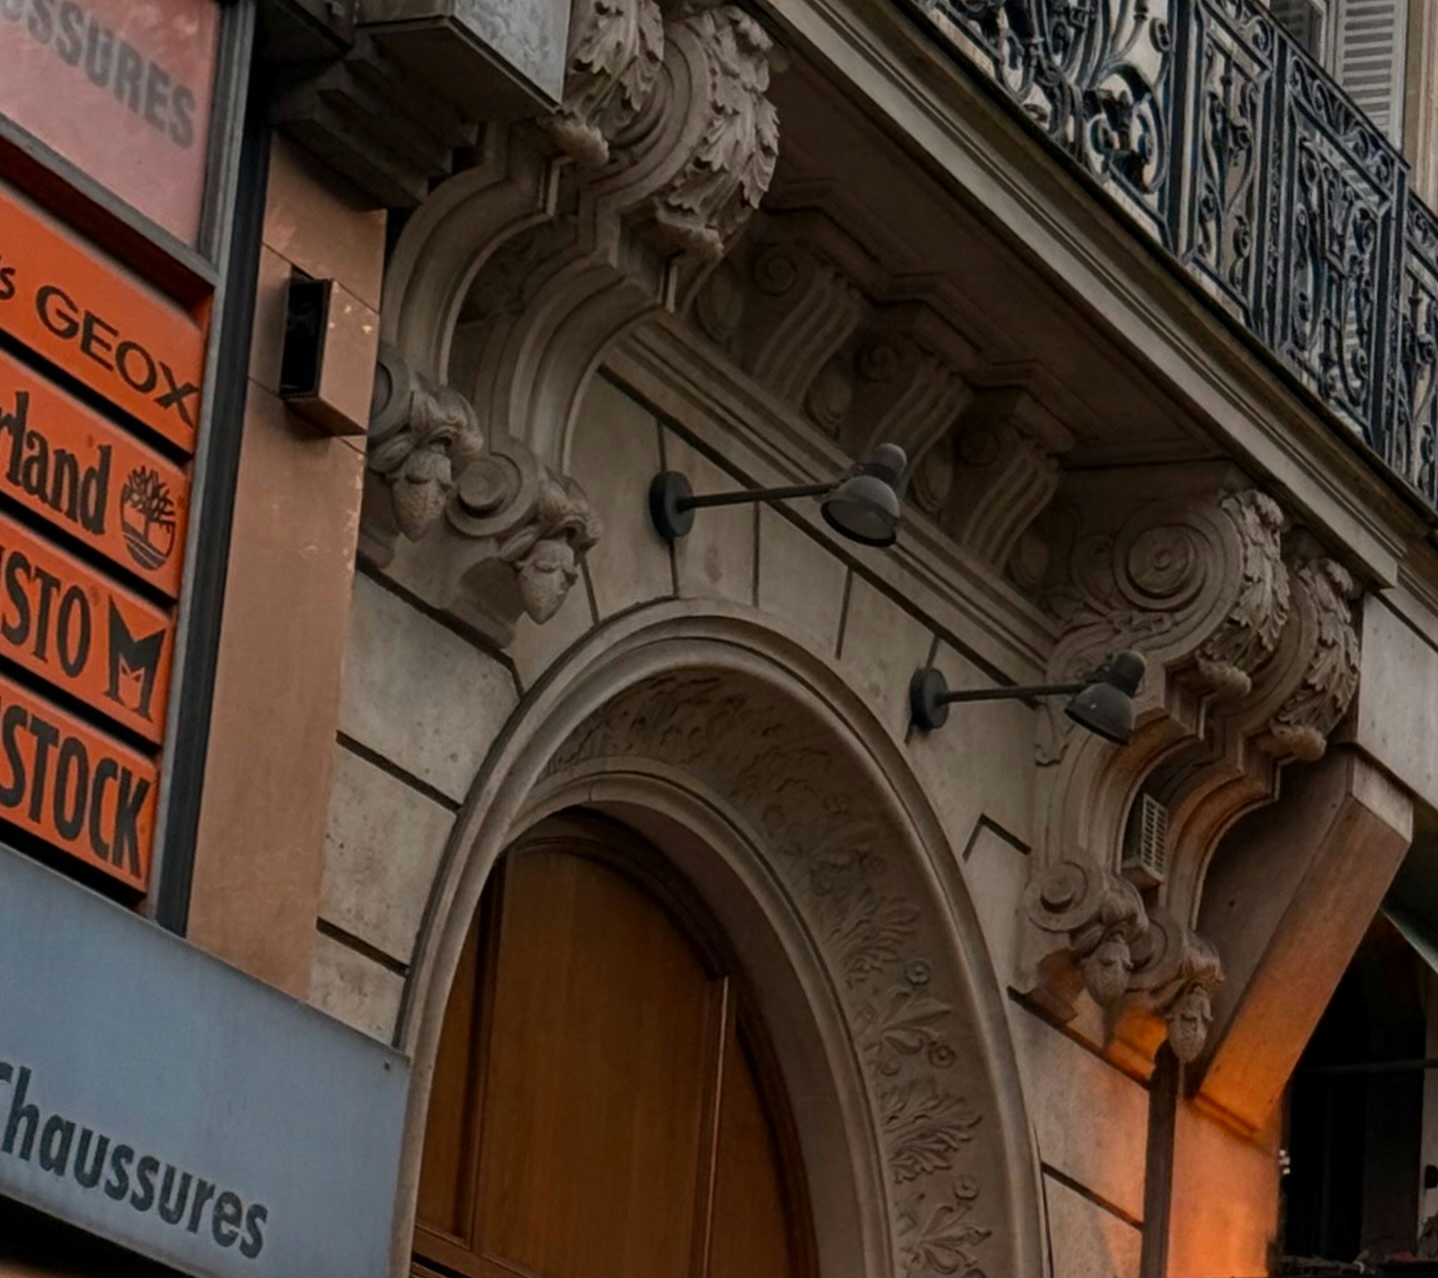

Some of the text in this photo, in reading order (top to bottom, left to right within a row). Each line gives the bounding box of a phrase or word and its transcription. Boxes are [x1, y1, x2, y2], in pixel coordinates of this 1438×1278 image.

[36, 285, 200, 428] GEOX
[0, 545, 91, 678] STO
[0, 1061, 269, 1259] haussures
